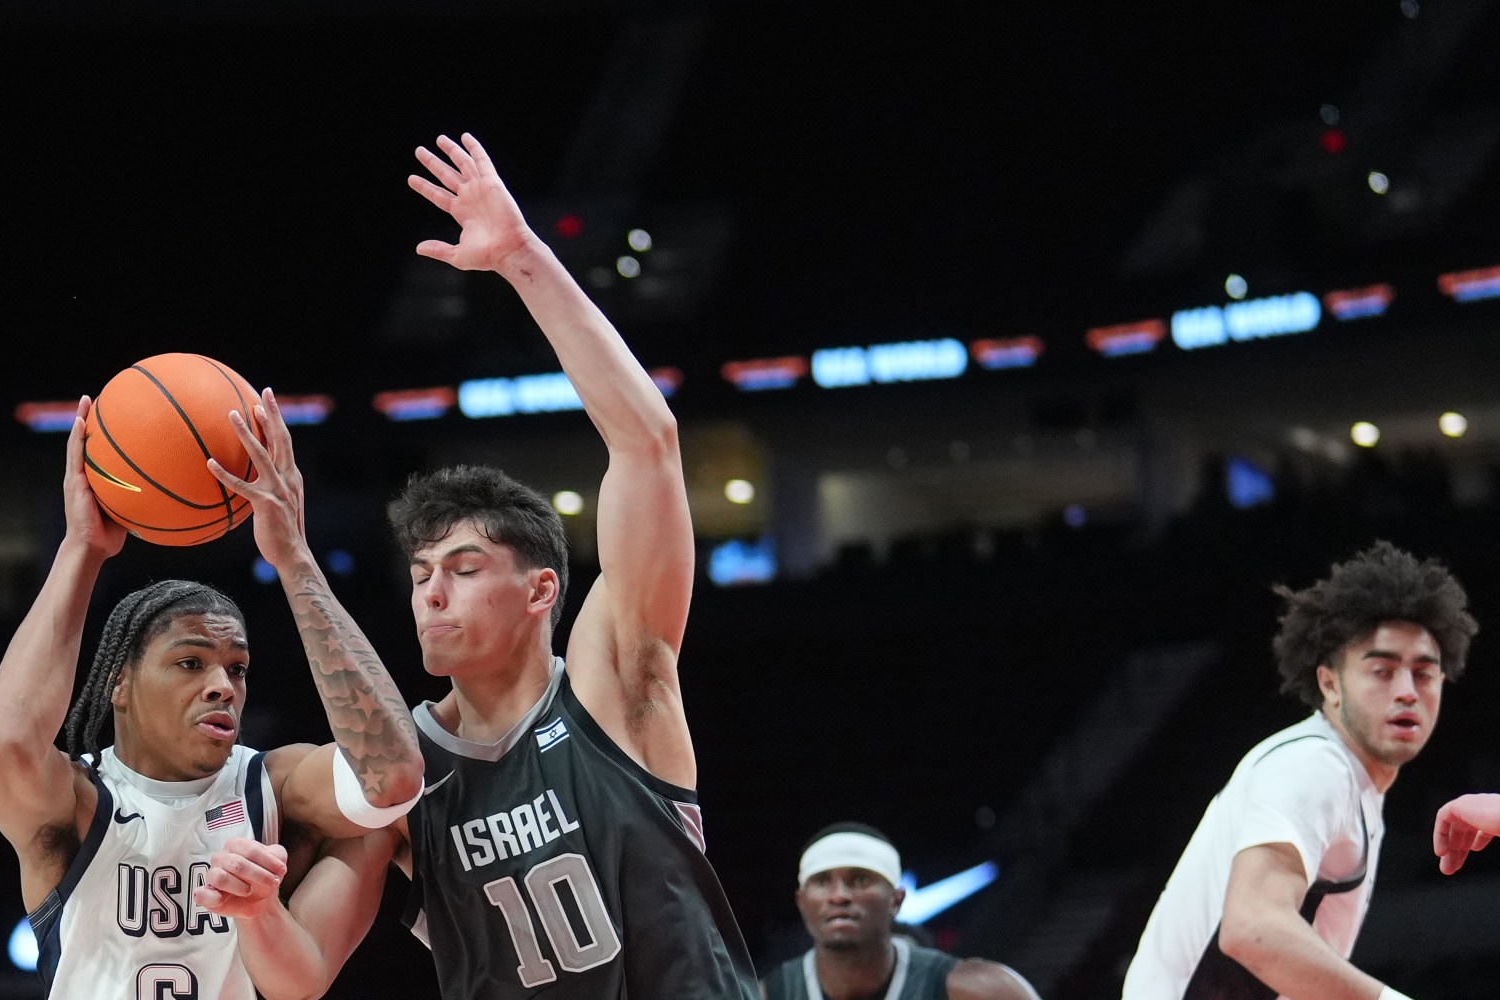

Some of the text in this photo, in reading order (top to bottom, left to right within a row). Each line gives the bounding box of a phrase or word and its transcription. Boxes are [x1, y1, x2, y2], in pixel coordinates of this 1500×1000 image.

[450, 789, 580, 872] ISRAEL
[117, 863, 229, 938] USA
[483, 853, 621, 988] 10
